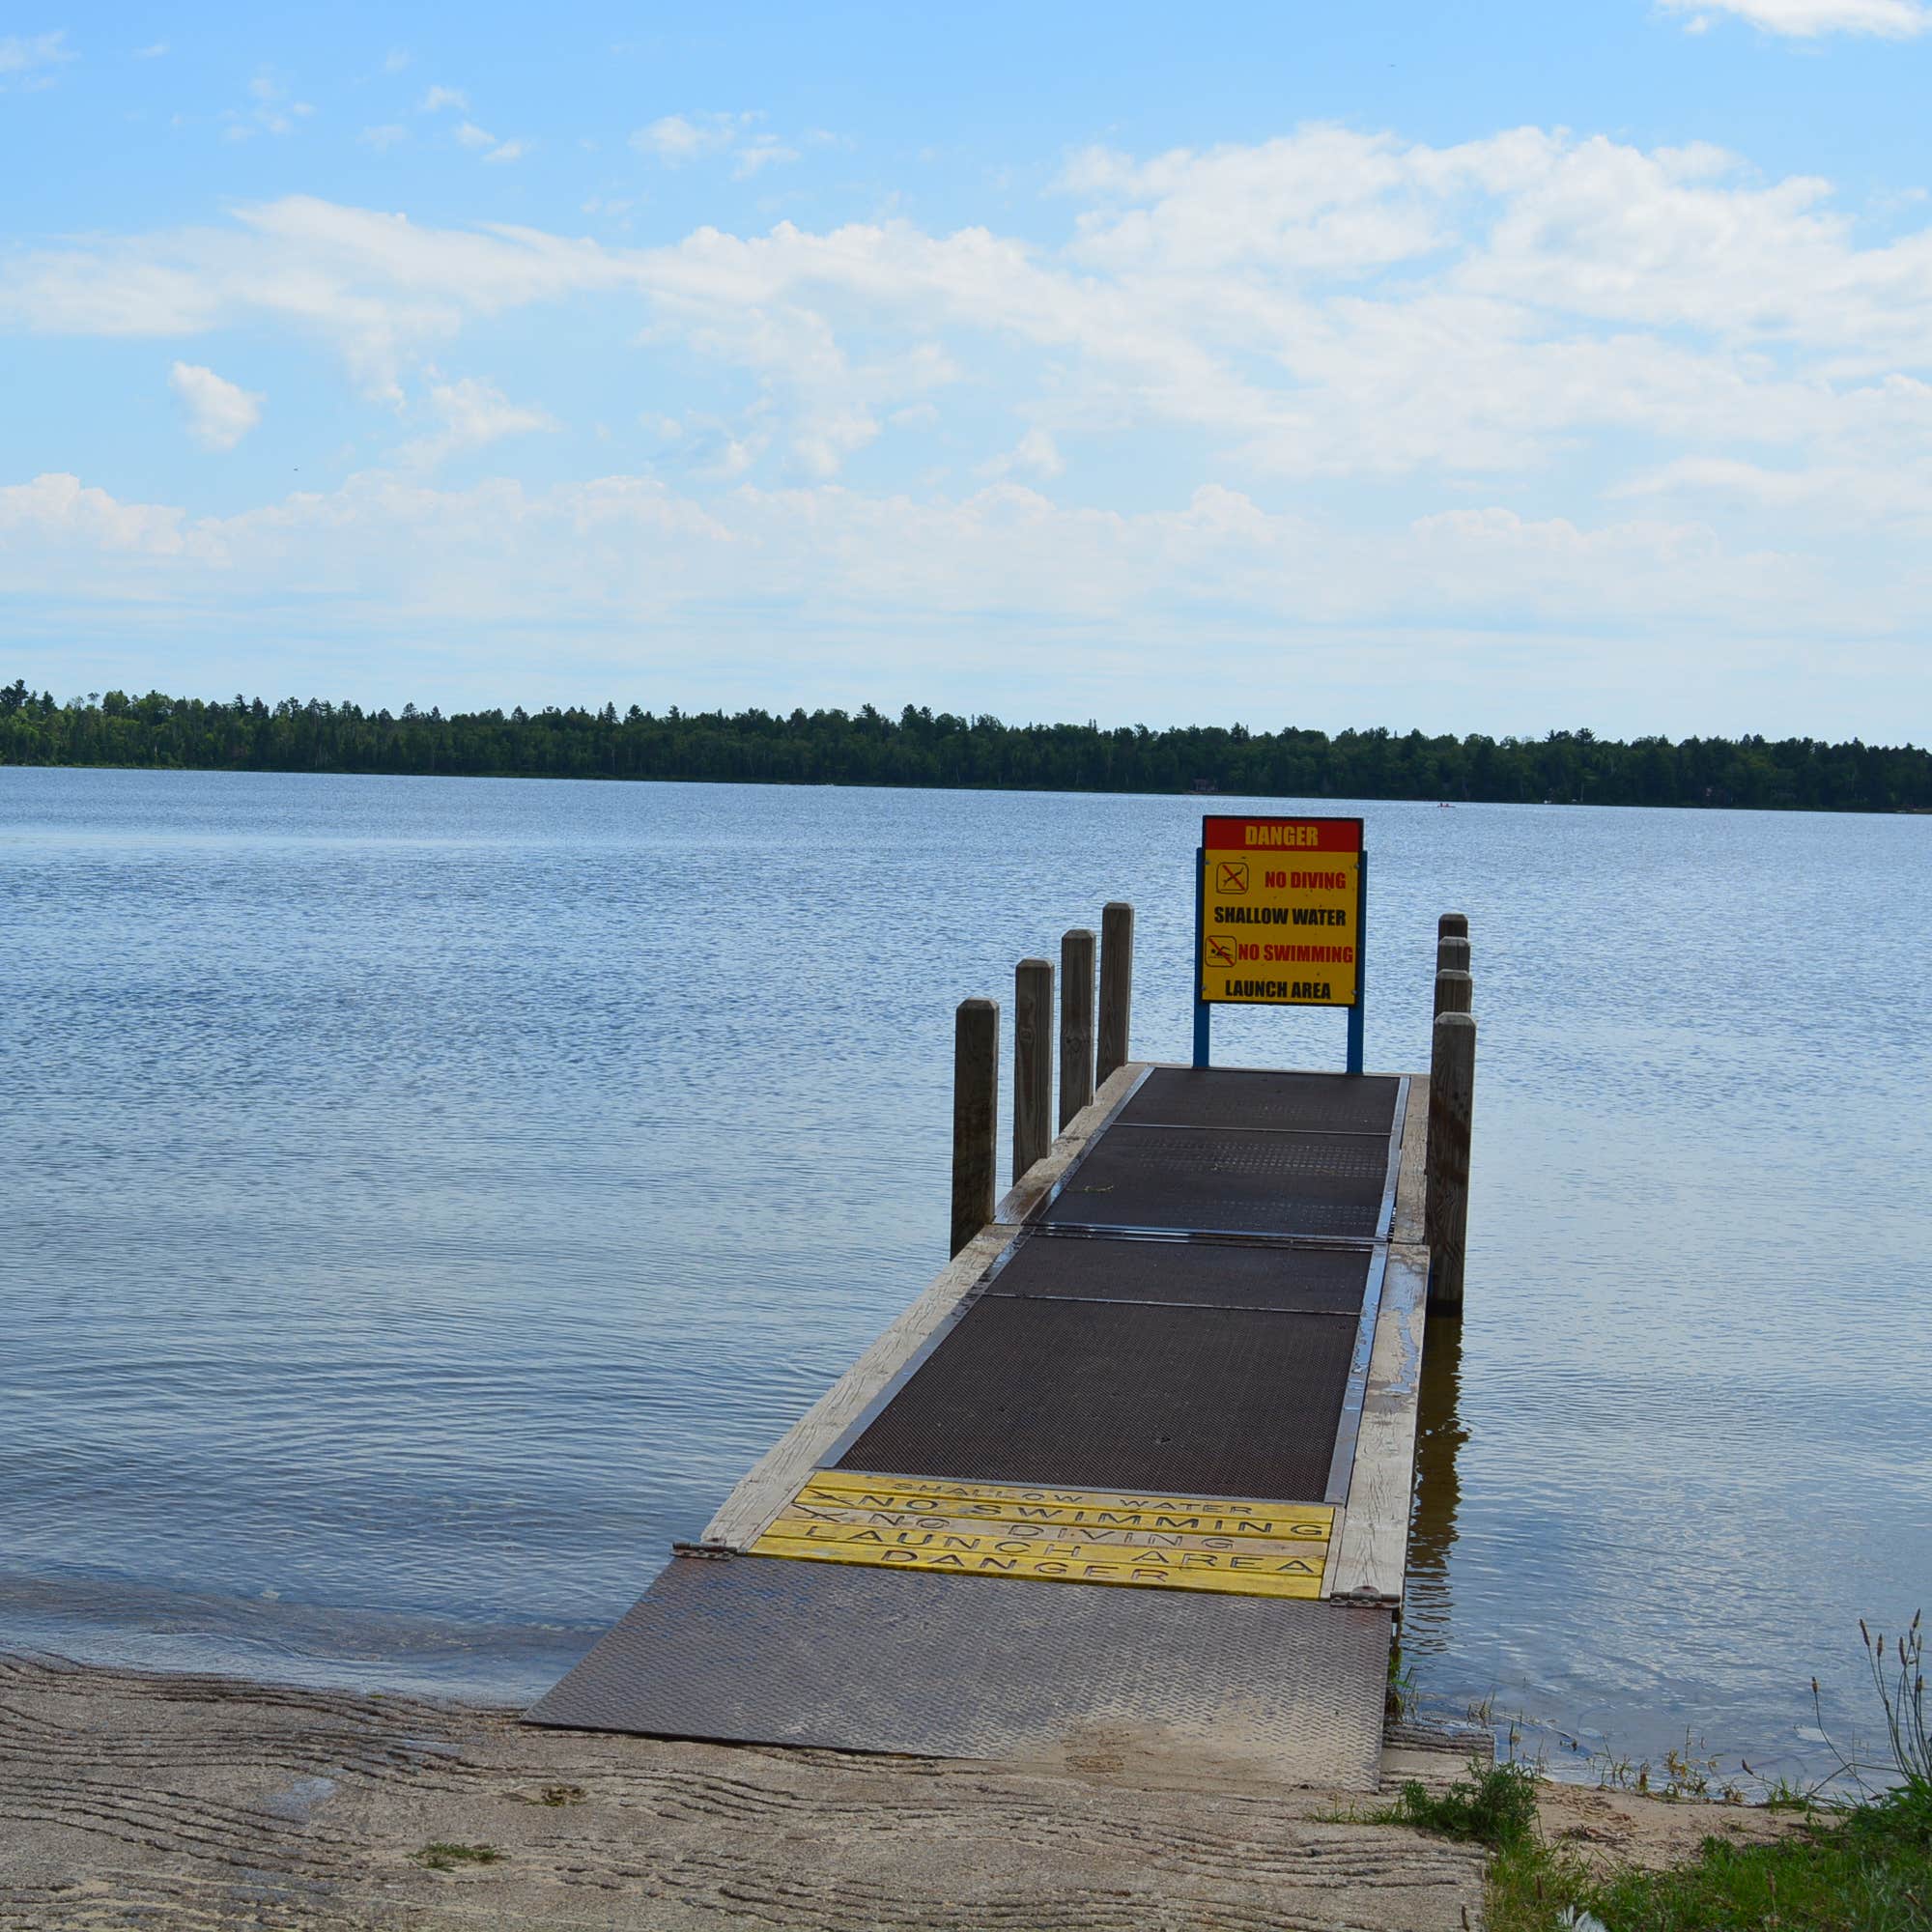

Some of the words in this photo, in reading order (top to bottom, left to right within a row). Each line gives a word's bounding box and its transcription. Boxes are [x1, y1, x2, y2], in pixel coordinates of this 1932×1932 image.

[1245, 826, 1319, 846] DANGER
[1264, 871, 1287, 889] NO
[1291, 871, 1346, 889] DIVING
[1214, 906, 1289, 925] SHALLOW
[1292, 908, 1347, 926] WATER
[1237, 944, 1260, 960] NO
[1264, 945, 1353, 963] SWIMMING
[1225, 980, 1288, 998] LAUNCH
[1291, 981, 1331, 999] AREA
[891, 1482, 1083, 1502] SHALLOW
[1120, 1498, 1253, 1516] WATER
[858, 1494, 939, 1510] NO
[971, 1504, 1322, 1536] SWIMMING
[867, 1513, 951, 1529] NO
[1008, 1524, 1236, 1549] DIVING
[805, 1525, 1082, 1557] LAUNCH
[1131, 1549, 1315, 1574] AREA
[881, 1549, 1169, 1582] DANGER
